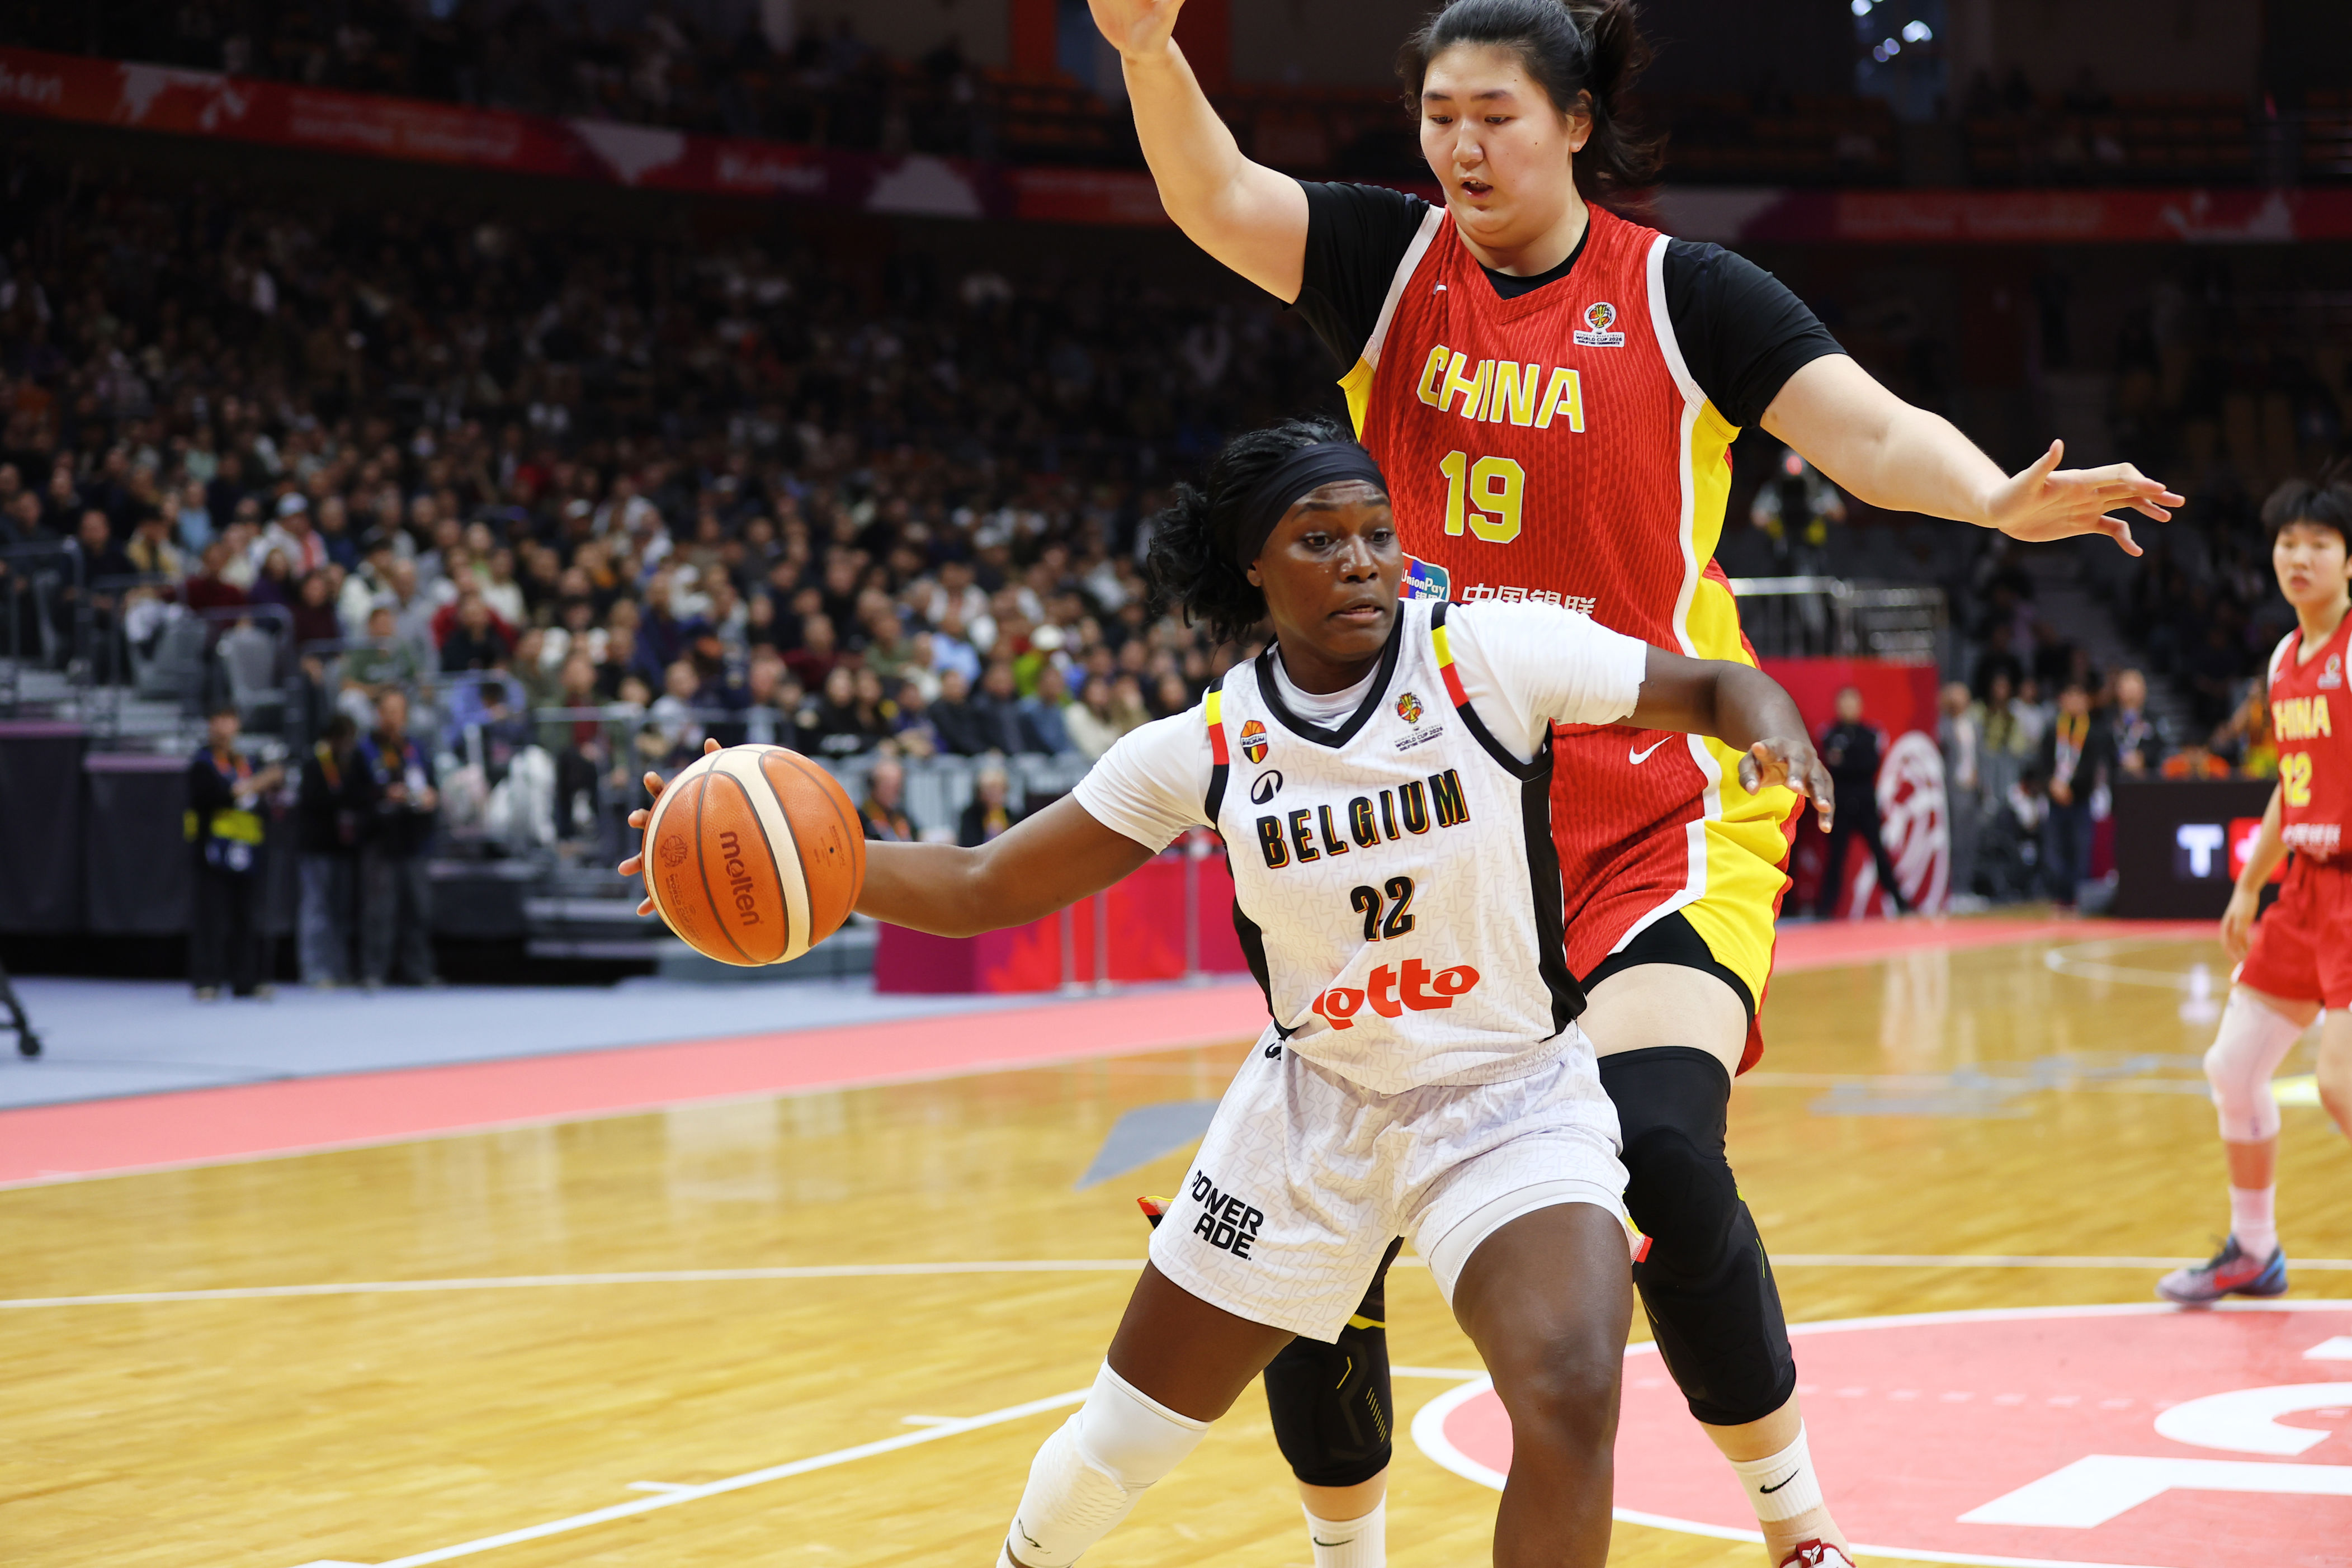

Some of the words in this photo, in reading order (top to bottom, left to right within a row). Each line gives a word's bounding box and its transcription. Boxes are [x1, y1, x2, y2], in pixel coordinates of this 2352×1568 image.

[1416, 344, 1585, 433] CHINA
[1439, 450, 1525, 544] 19
[1401, 568, 1446, 599] UnionPay
[1395, 737, 1416, 748] WORLD
[1429, 726, 1443, 735] 2026
[2272, 695, 2331, 742] HINA
[2279, 752, 2312, 807] 12
[1257, 768, 1470, 869] BELGIUM
[670, 873, 681, 905] WORLD
[720, 831, 760, 926] molten
[1350, 876, 1415, 942] 22
